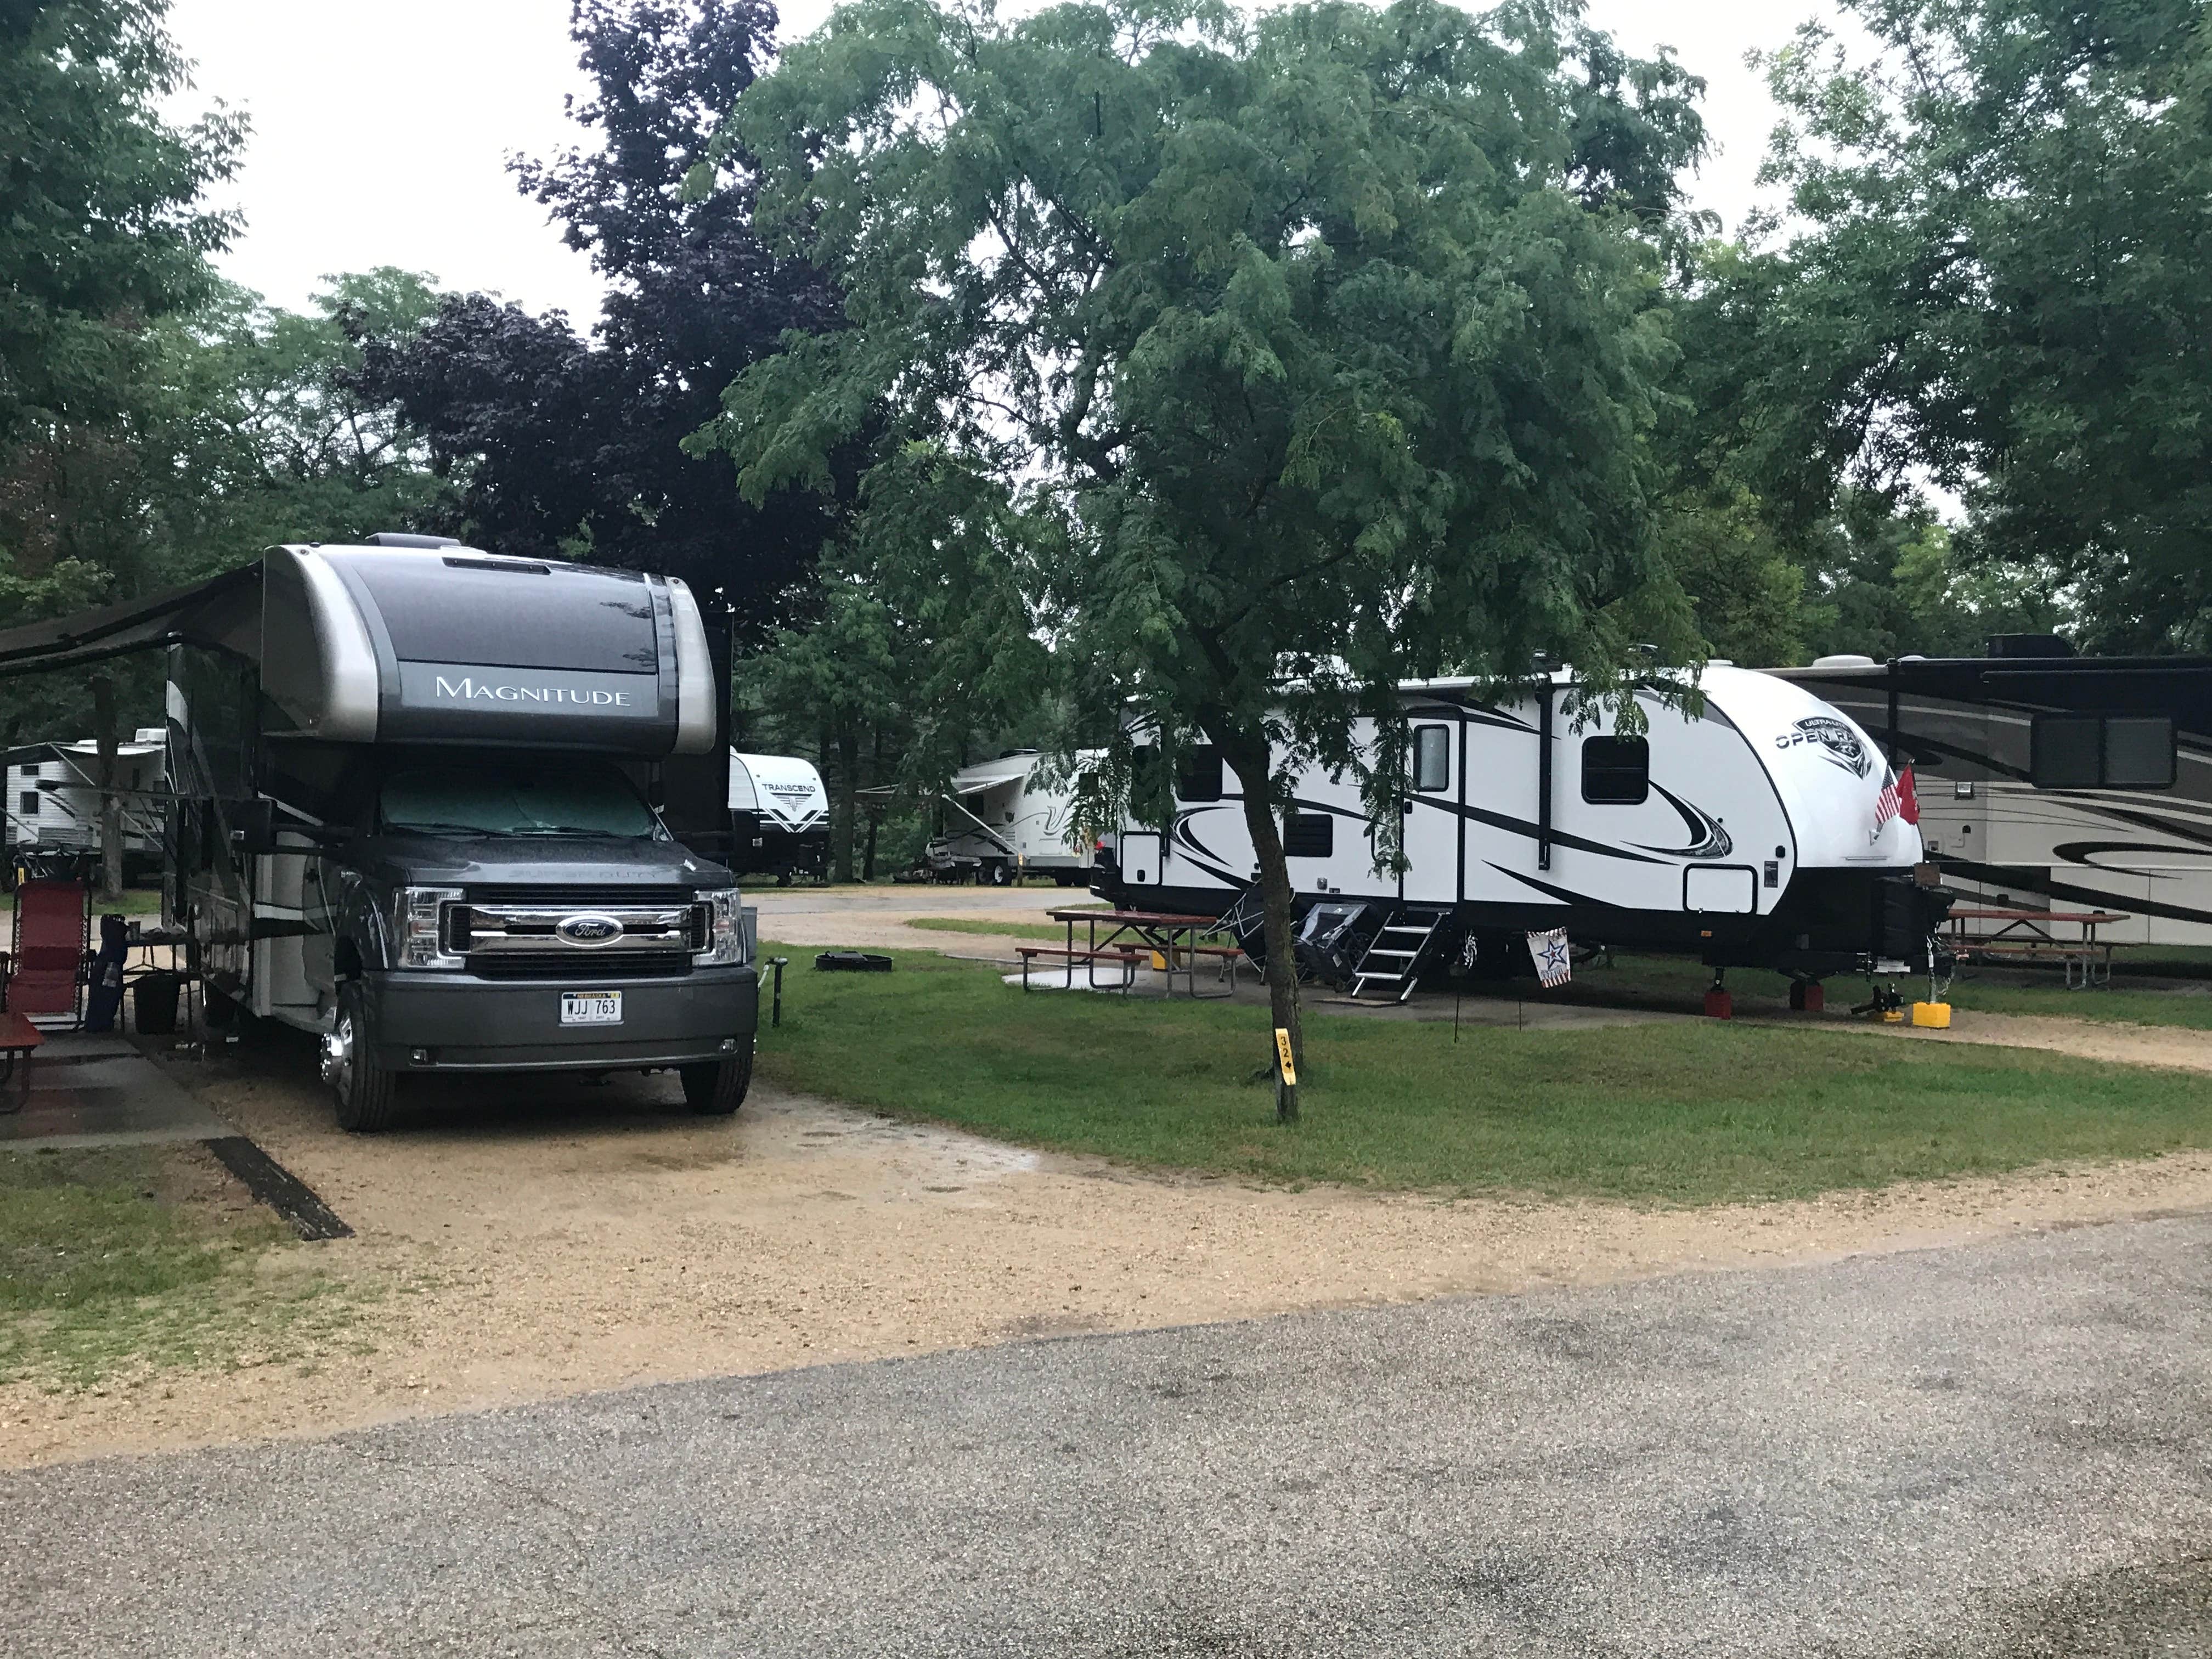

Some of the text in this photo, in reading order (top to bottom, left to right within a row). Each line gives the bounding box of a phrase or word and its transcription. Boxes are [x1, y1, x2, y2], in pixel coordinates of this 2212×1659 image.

[1775, 728, 1831, 749] OPEN
[761, 783, 816, 792] TRANSCEND
[574, 923, 606, 936] Ford
[567, 1000, 616, 1015] WJJ 763
